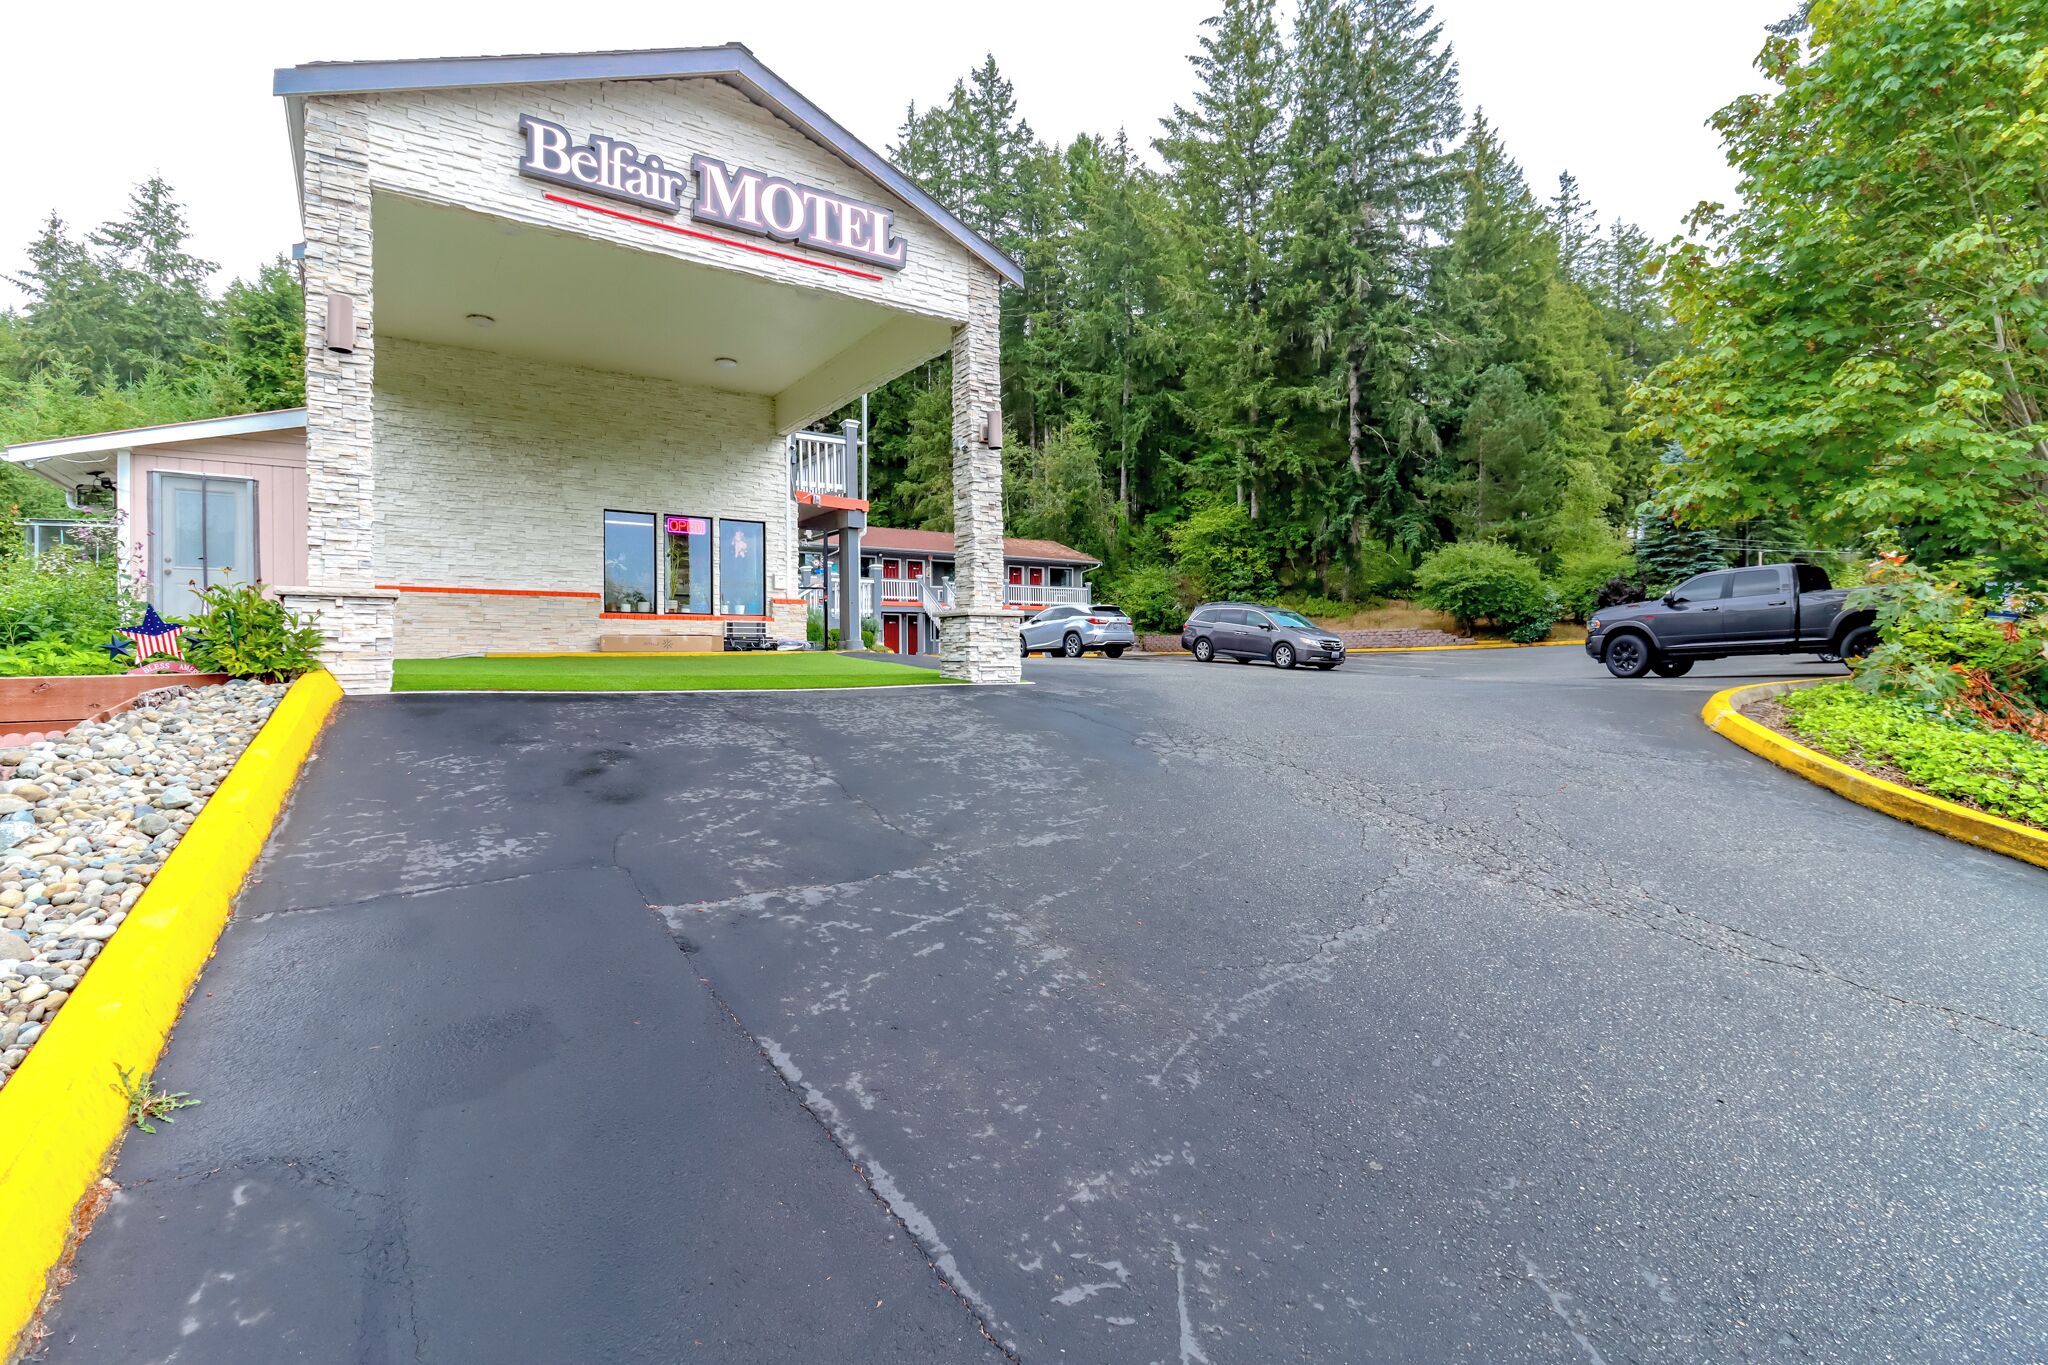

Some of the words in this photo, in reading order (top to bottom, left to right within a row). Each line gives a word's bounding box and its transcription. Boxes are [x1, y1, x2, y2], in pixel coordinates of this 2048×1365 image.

[525, 119, 683, 206] Belfair
[699, 159, 903, 262] MOTEL
[142, 662, 171, 674] BLESS
[179, 663, 199, 675] AMER
